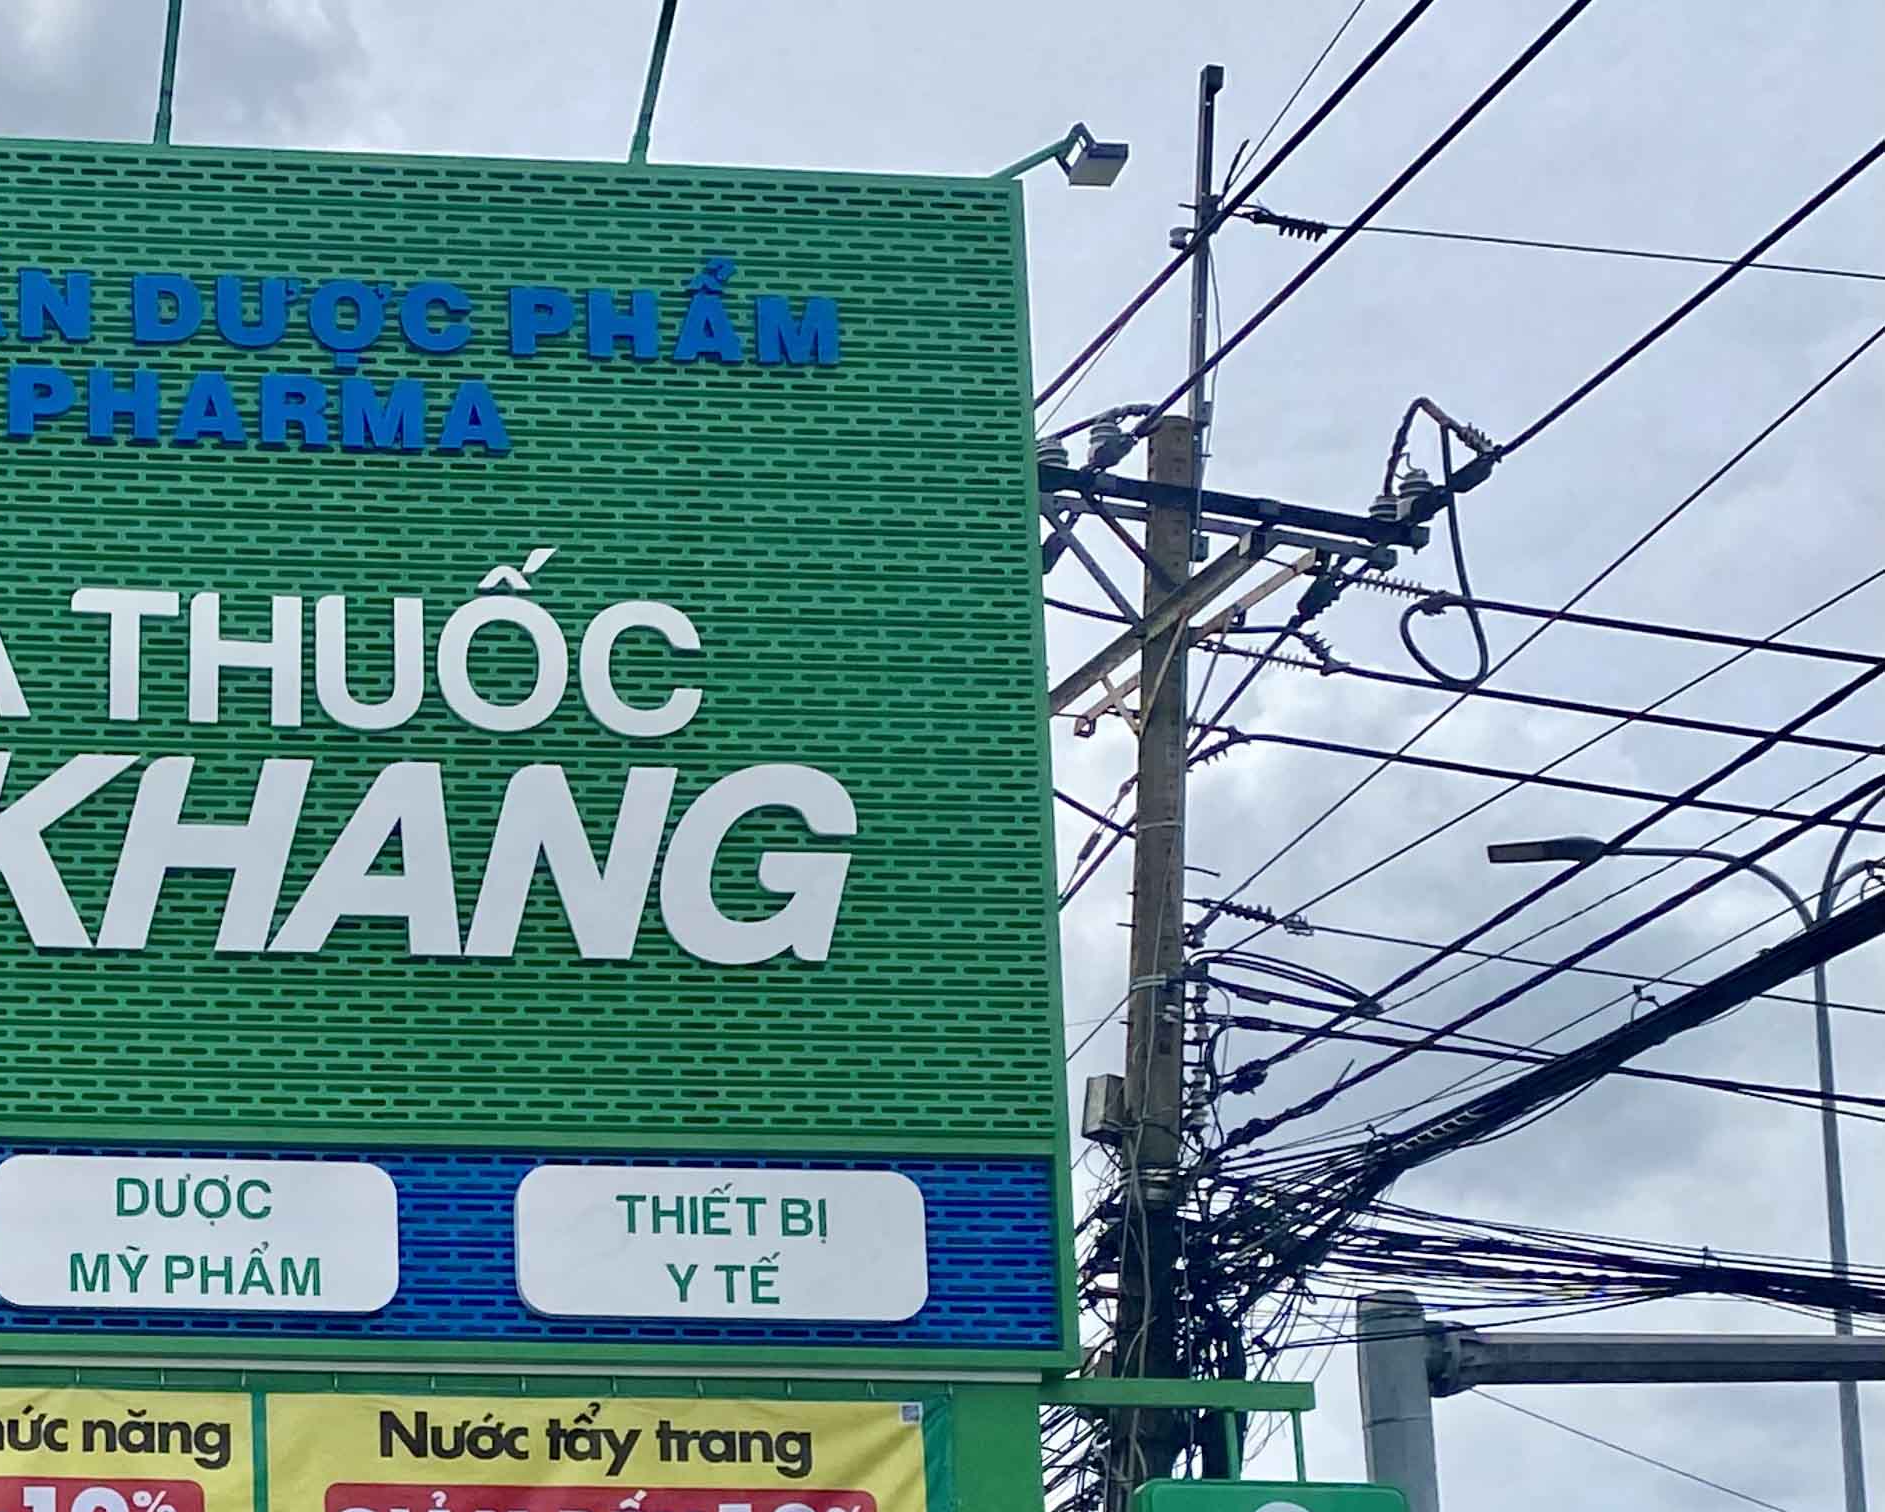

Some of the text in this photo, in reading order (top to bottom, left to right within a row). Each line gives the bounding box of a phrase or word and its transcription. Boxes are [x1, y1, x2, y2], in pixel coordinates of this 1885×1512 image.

[133, 272, 473, 374] DƯỢC
[509, 257, 841, 367] PHẨM
[8, 363, 512, 453] PHARMA
[70, 547, 703, 737] THUỐC
[115, 1172, 273, 1227] DƯỢC
[615, 1182, 829, 1246] THIẾT BỊ
[68, 1240, 322, 1298] MỸ PHẨM
[667, 1252, 782, 1306] Y TẾ
[82, 1408, 232, 1470] năng
[379, 1401, 814, 1480] Nước tẩy trang
